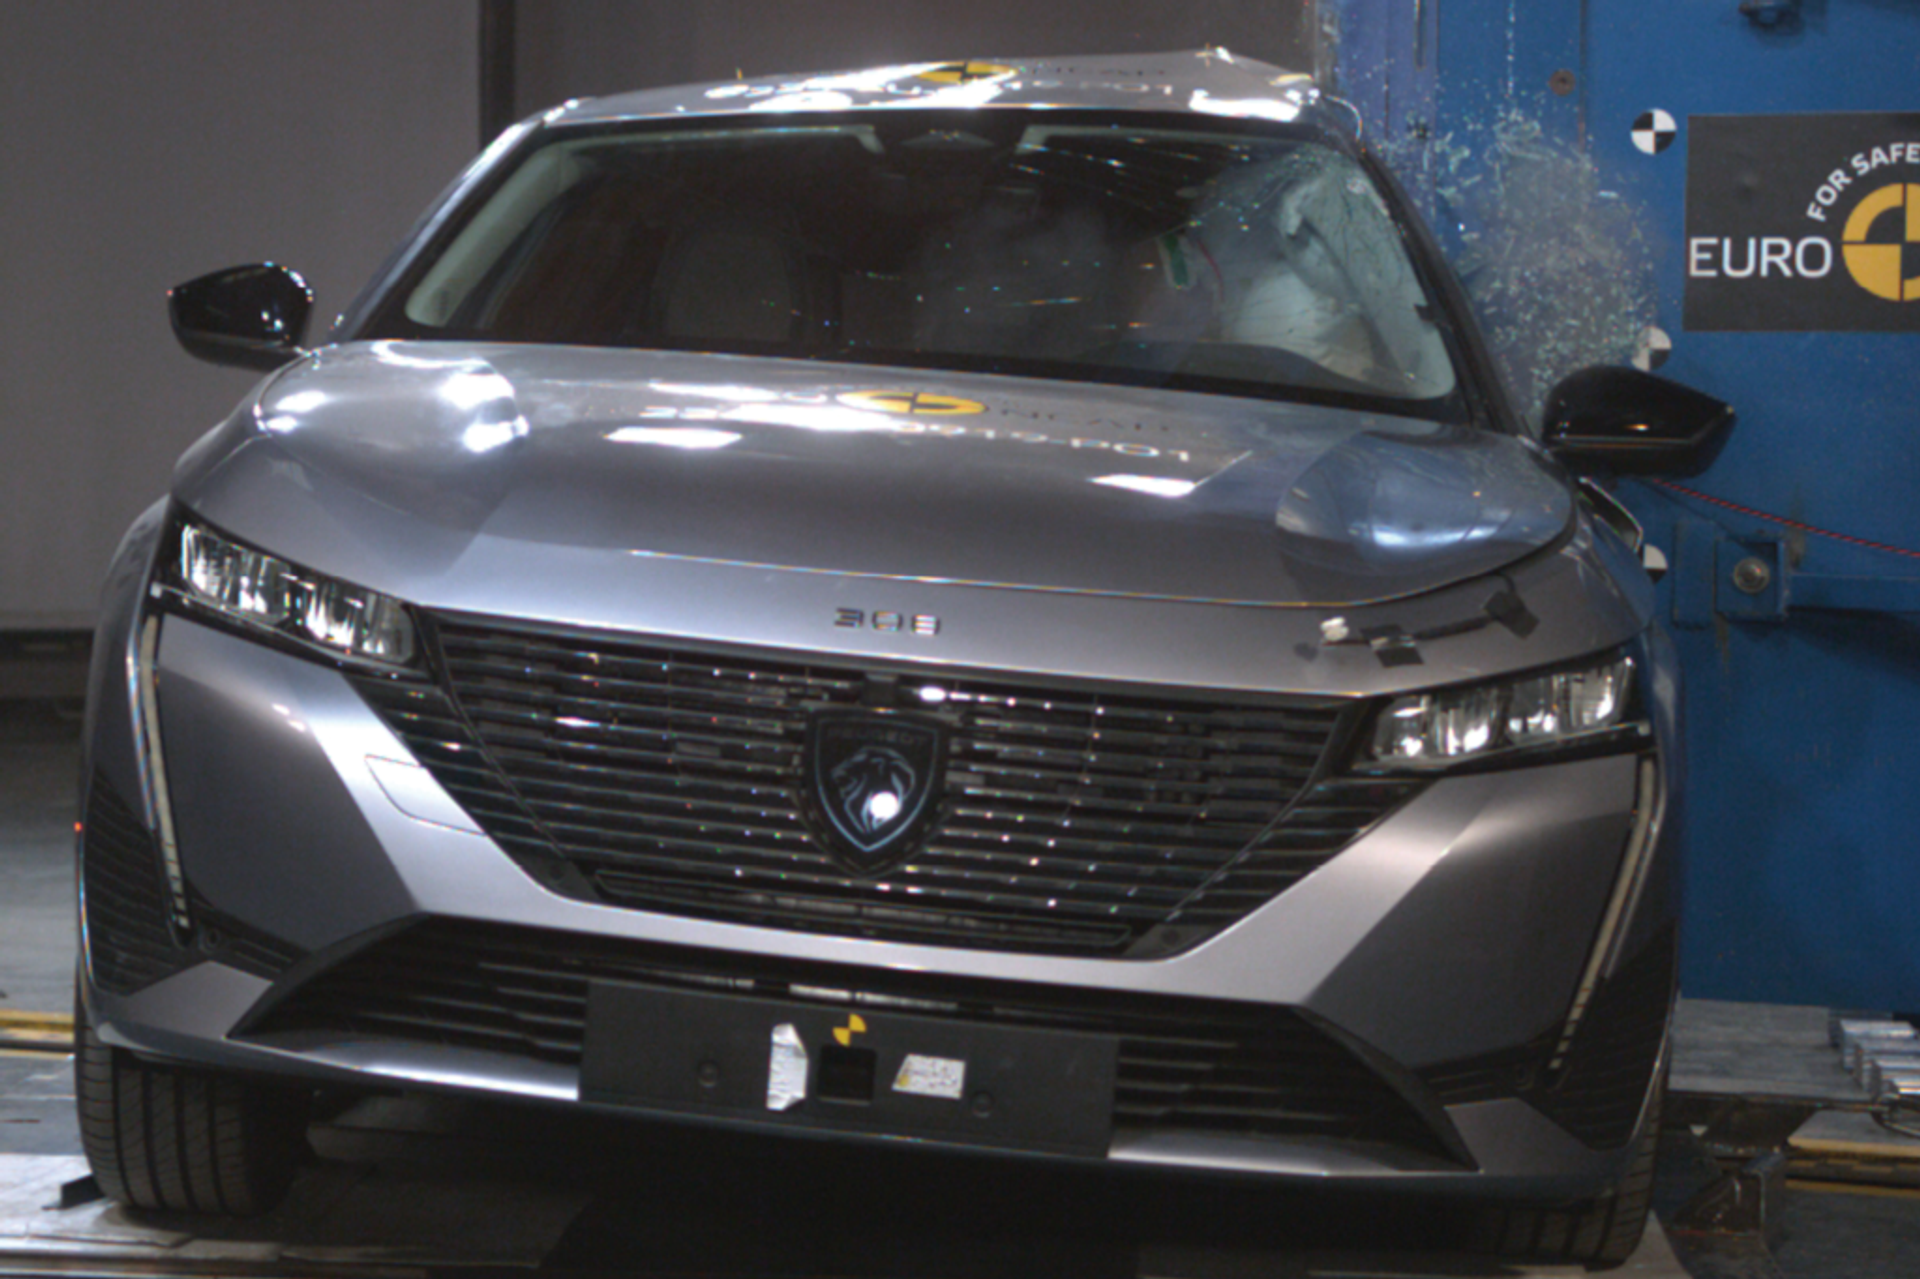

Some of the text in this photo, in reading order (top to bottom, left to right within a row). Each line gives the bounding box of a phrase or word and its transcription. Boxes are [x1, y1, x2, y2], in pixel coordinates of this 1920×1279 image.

[1806, 142, 1920, 222] FOR SAFE
[1689, 236, 1833, 279] EURO
[834, 607, 941, 636] 308
